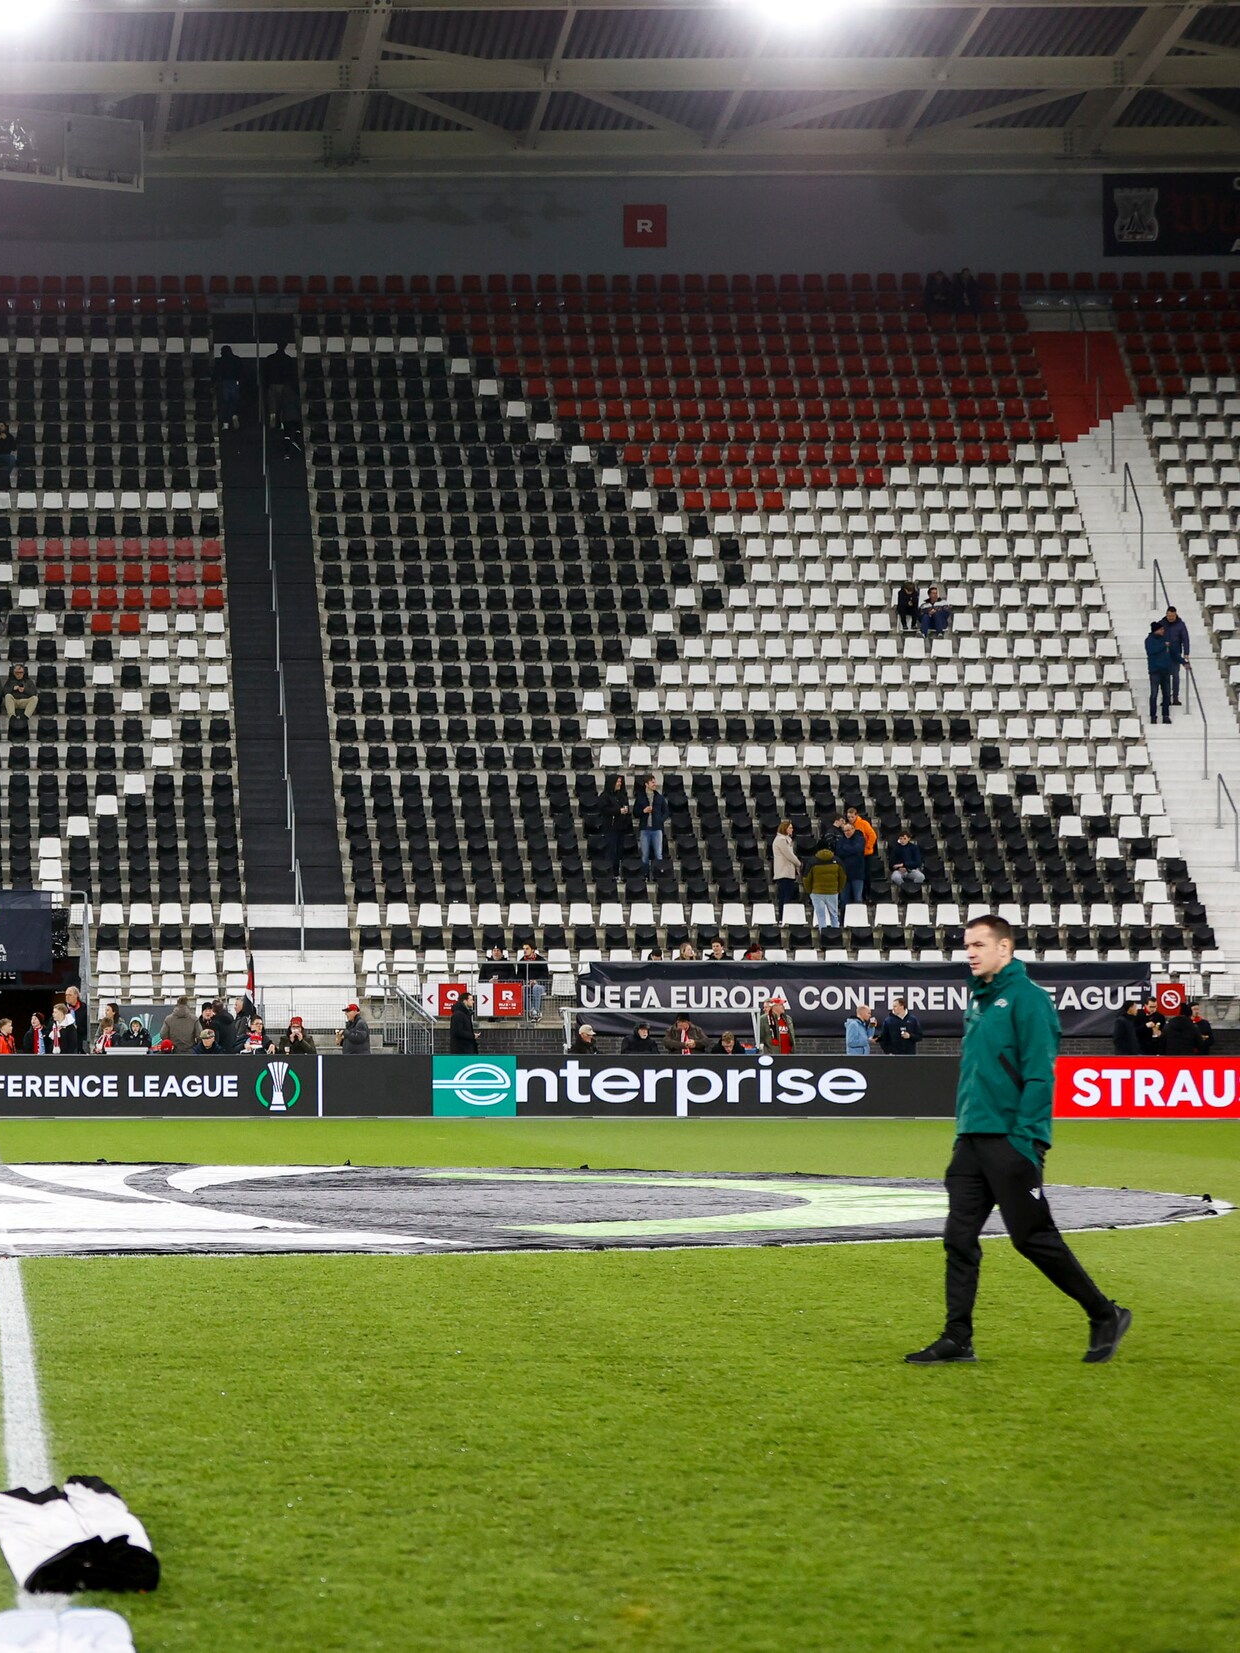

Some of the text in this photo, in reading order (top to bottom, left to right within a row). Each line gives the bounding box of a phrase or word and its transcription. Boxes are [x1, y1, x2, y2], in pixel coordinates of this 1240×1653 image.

[636, 220, 653, 233] R
[446, 990, 459, 1002] Q
[501, 990, 514, 1001] R
[580, 985, 664, 1009] UEFA
[670, 985, 791, 1010] EUROPA
[798, 985, 974, 1011] CONFEREN
[128, 1075, 239, 1098] LEAGUE
[433, 1056, 868, 1117] enterprise
[1071, 1068, 1240, 1109] STRAU
